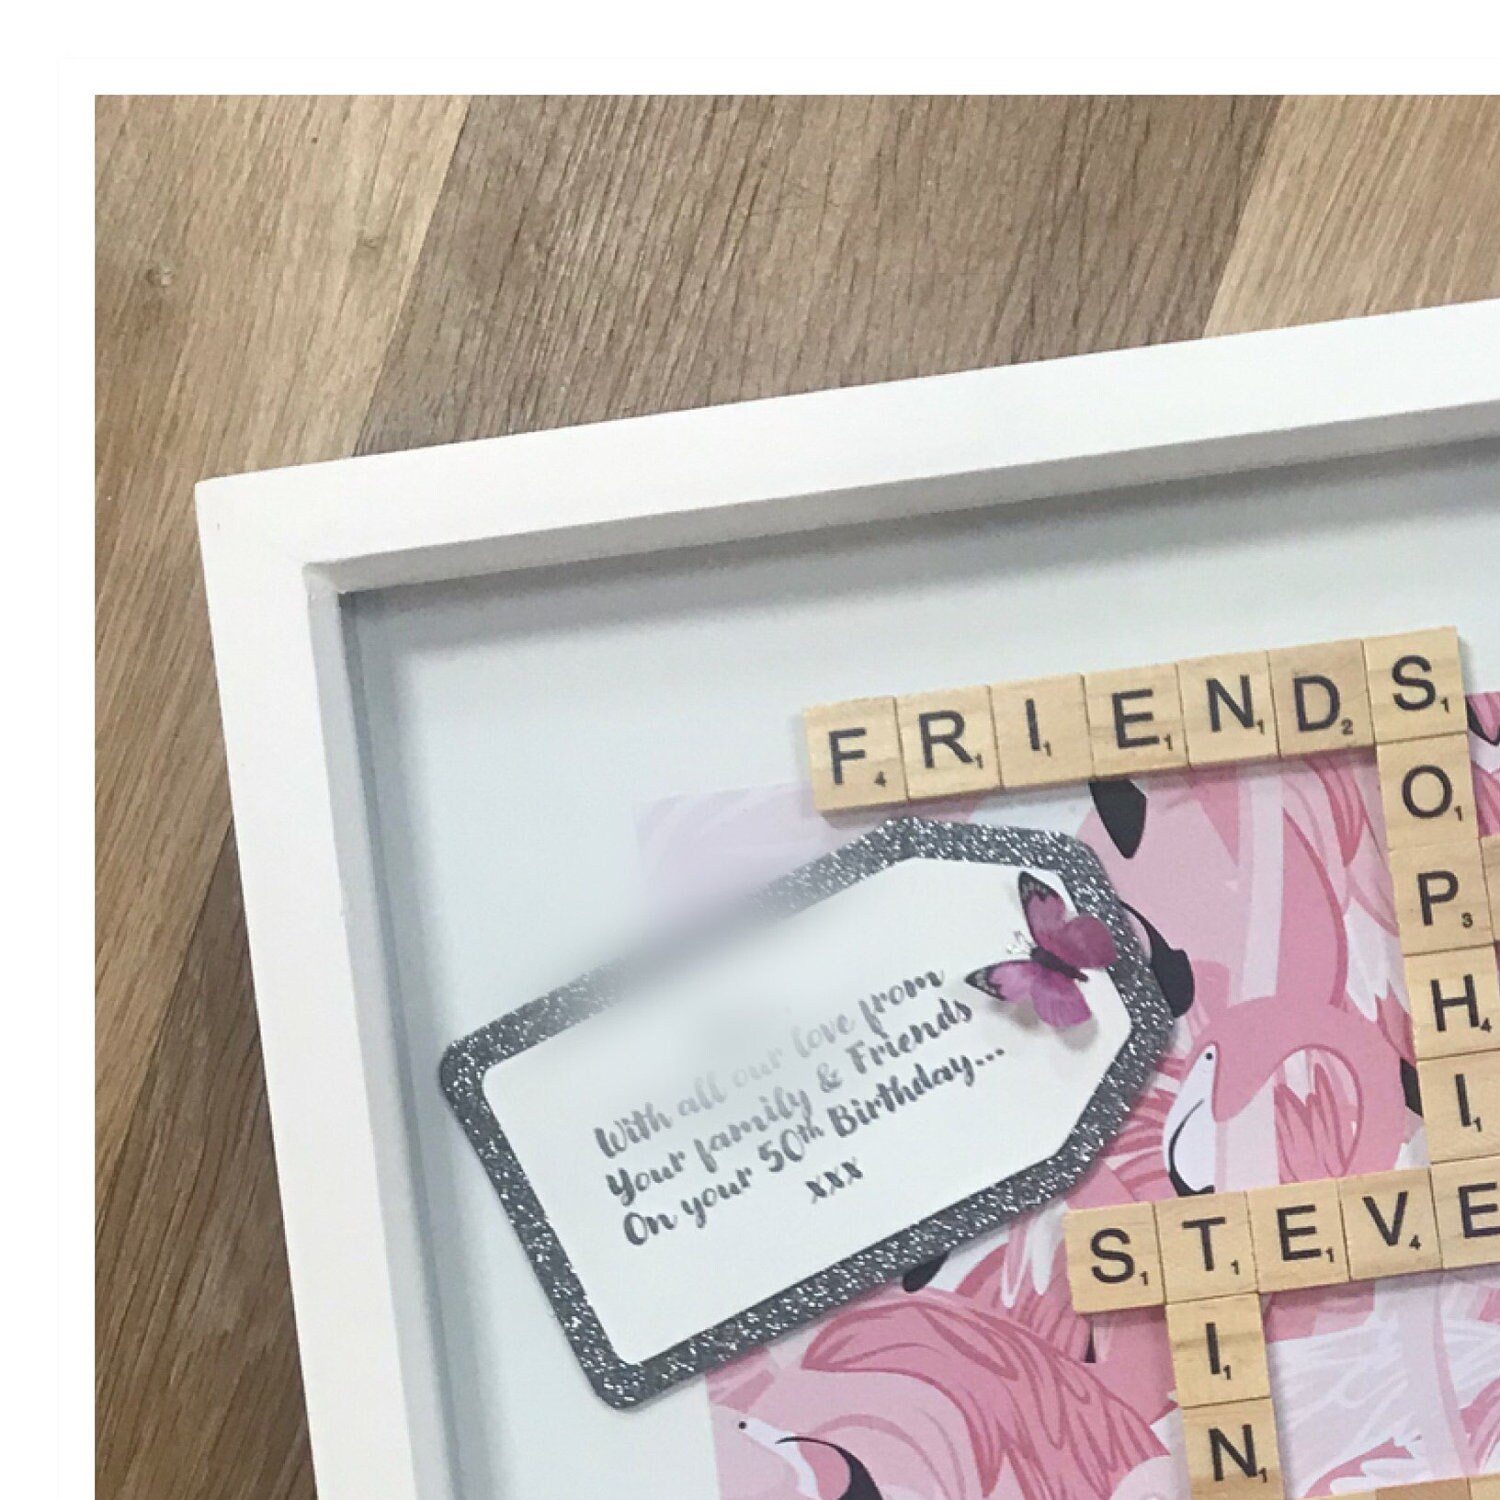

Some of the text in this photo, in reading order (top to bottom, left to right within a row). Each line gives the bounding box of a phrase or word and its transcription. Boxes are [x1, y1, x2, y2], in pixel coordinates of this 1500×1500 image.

[827, 654, 1437, 787] FRIENDS
[593, 1101, 673, 1159] With
[677, 1070, 727, 1117] all
[791, 1013, 855, 1059] love
[858, 969, 945, 1040] from
[605, 998, 973, 1208] Your family & Friends
[622, 1210, 679, 1246] On
[680, 1165, 754, 1230] your
[804, 1155, 864, 1205] xxx
